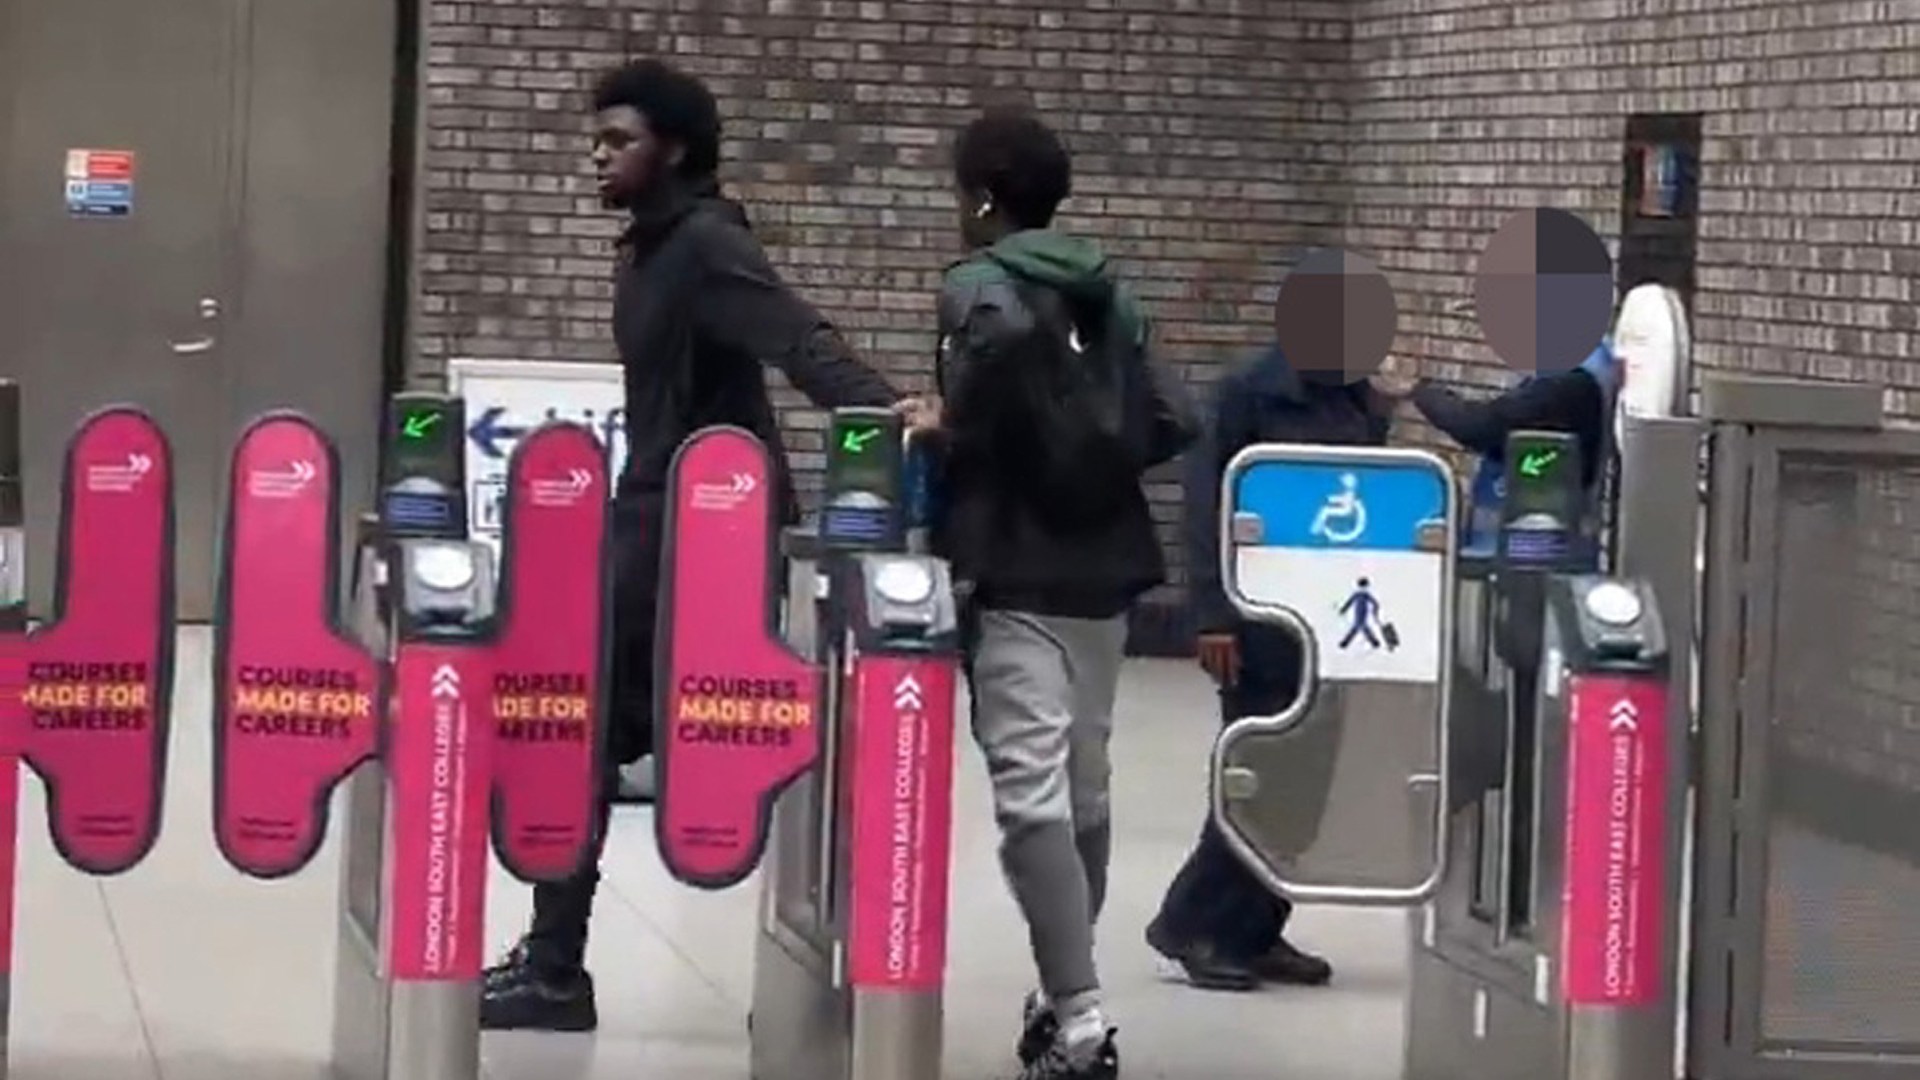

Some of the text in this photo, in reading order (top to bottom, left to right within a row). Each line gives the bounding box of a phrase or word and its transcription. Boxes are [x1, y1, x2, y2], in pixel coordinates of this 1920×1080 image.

[96, 684, 147, 707] FOR
[238, 665, 357, 690] COURSES
[494, 673, 586, 694] OURSES
[679, 675, 797, 699] COURSES
[236, 686, 371, 717] MADE FOR
[539, 696, 588, 719] FOR
[678, 696, 811, 727] MADE FOR
[236, 714, 351, 738] CAREERS
[677, 723, 793, 746] CAREERS
[430, 790, 448, 833] EAST
[893, 802, 911, 843] EAST
[1609, 820, 1626, 861] EAST
[427, 834, 446, 893] SOUTH
[890, 845, 910, 903] SOUTH
[1607, 864, 1624, 920] SOUTH
[424, 896, 444, 972] LONDON
[888, 906, 907, 979] LONDON
[1606, 923, 1621, 996] LONDON
